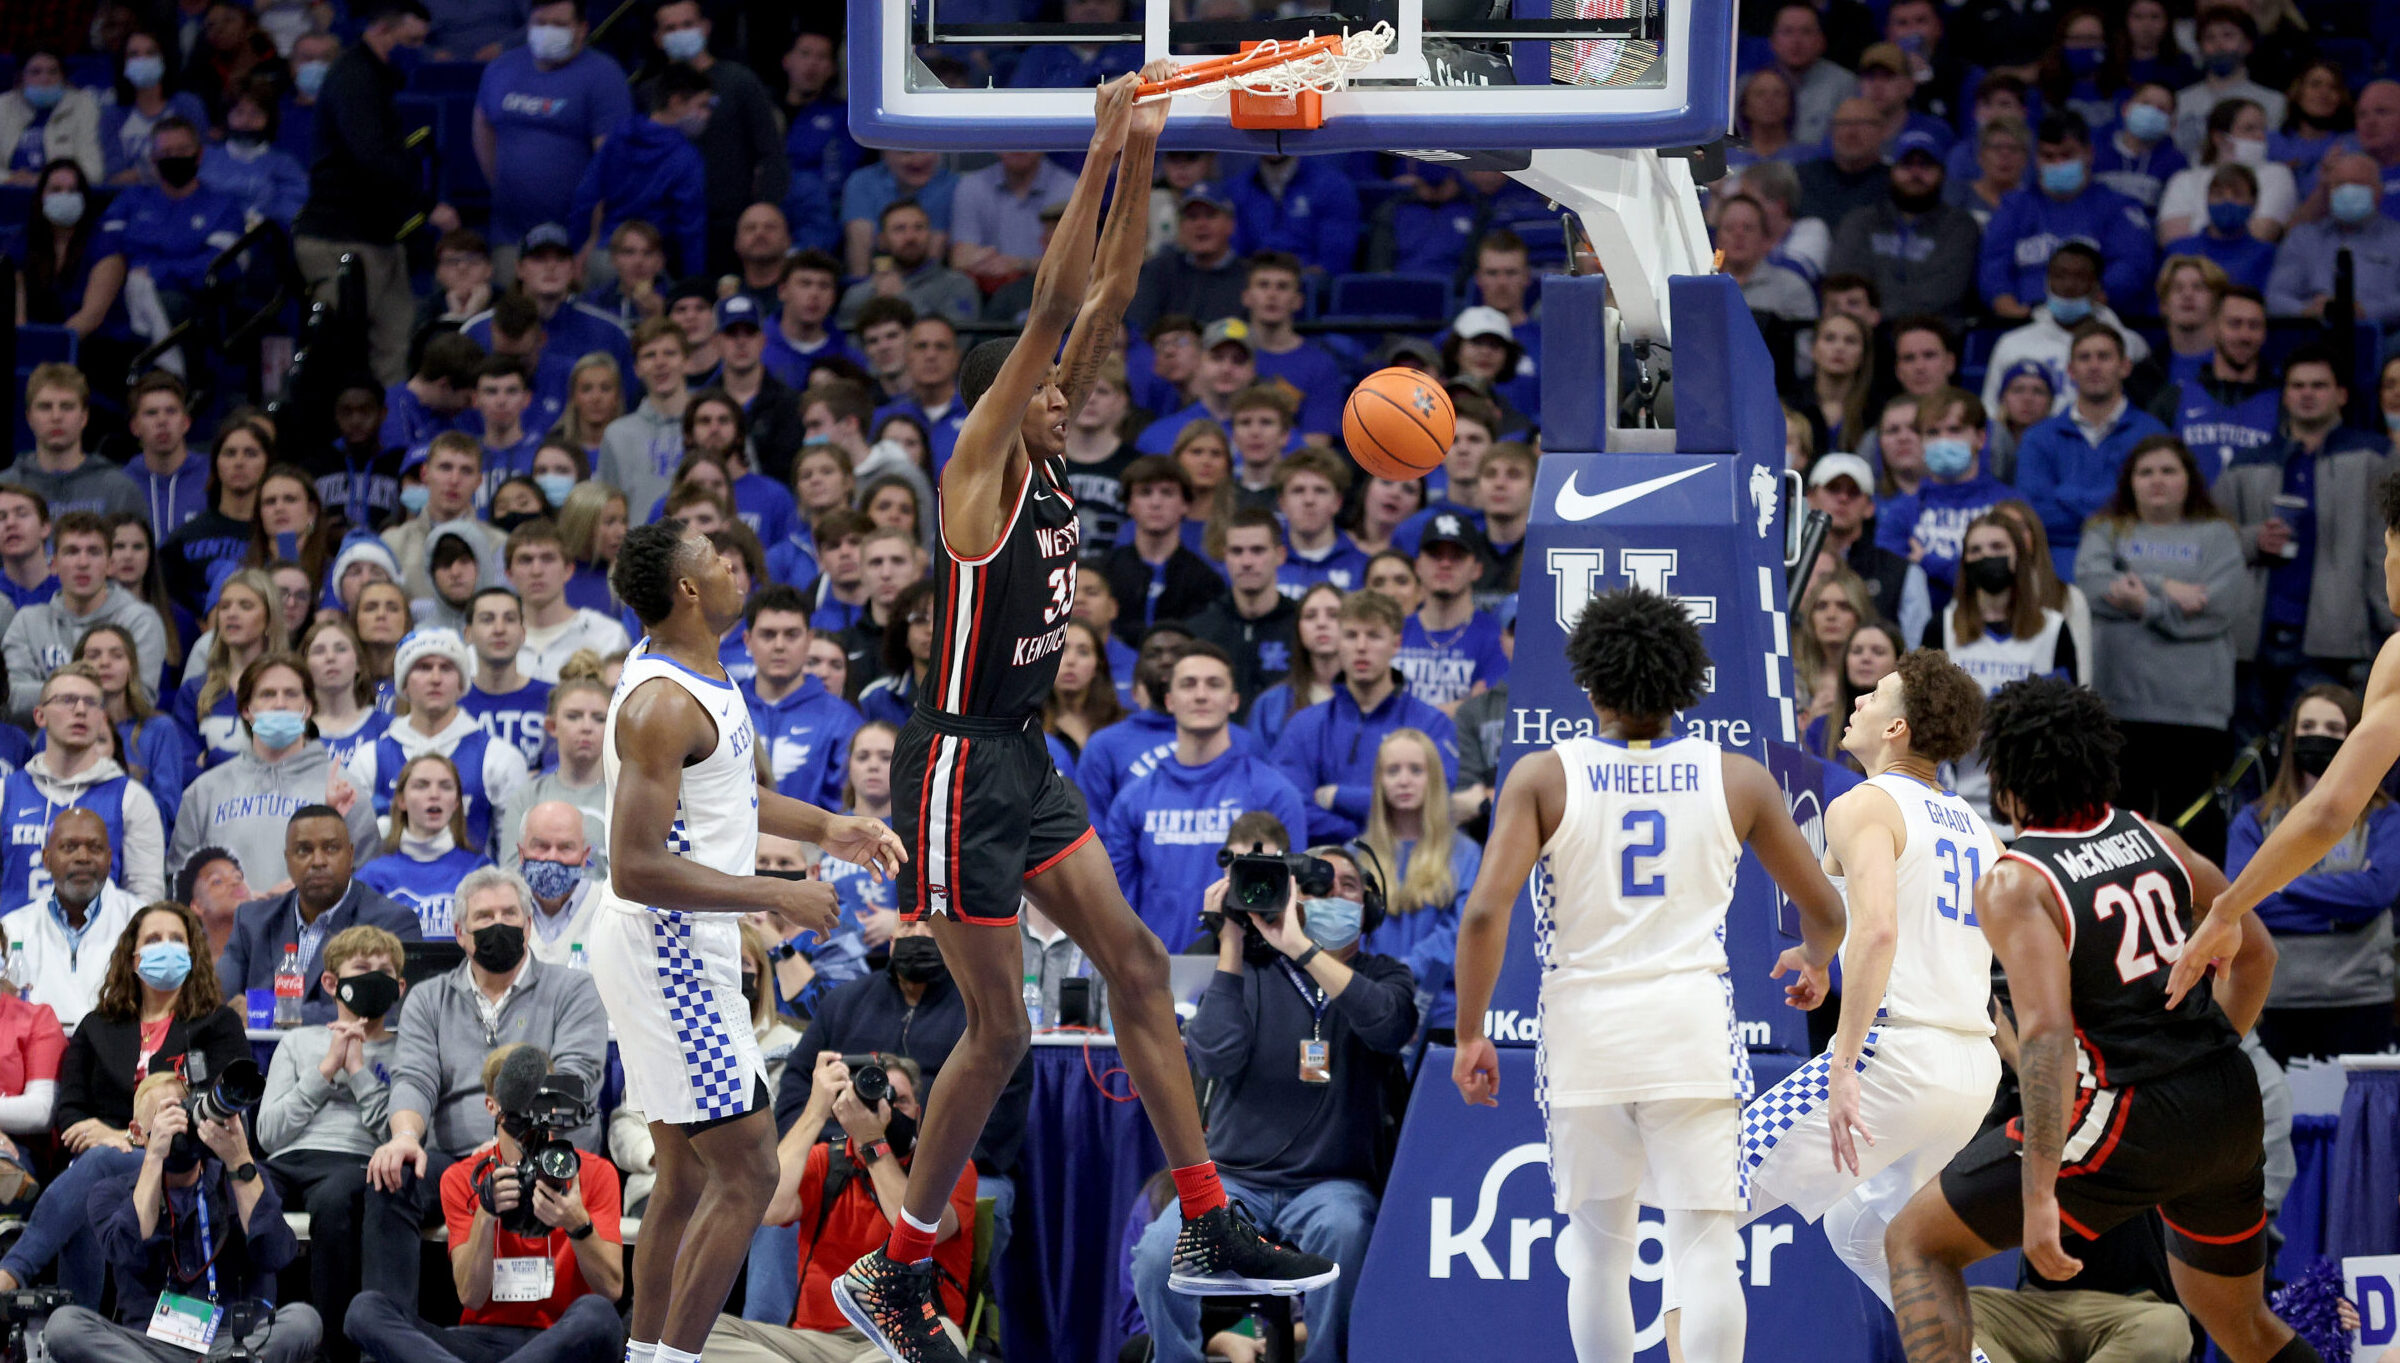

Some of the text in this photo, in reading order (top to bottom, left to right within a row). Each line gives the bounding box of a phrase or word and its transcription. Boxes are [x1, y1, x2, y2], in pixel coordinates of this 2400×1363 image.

[1044, 560, 1077, 626] 33
[1512, 708, 1751, 747] Heaare
[215, 794, 308, 824] KENTUCK
[1588, 761, 1699, 793] WHEELER
[1925, 800, 1975, 836] GRADY
[1621, 810, 1666, 897] 2
[1935, 838, 1981, 928] 31
[2093, 870, 2187, 985] 20
[1429, 1143, 1793, 1353] Krgr
